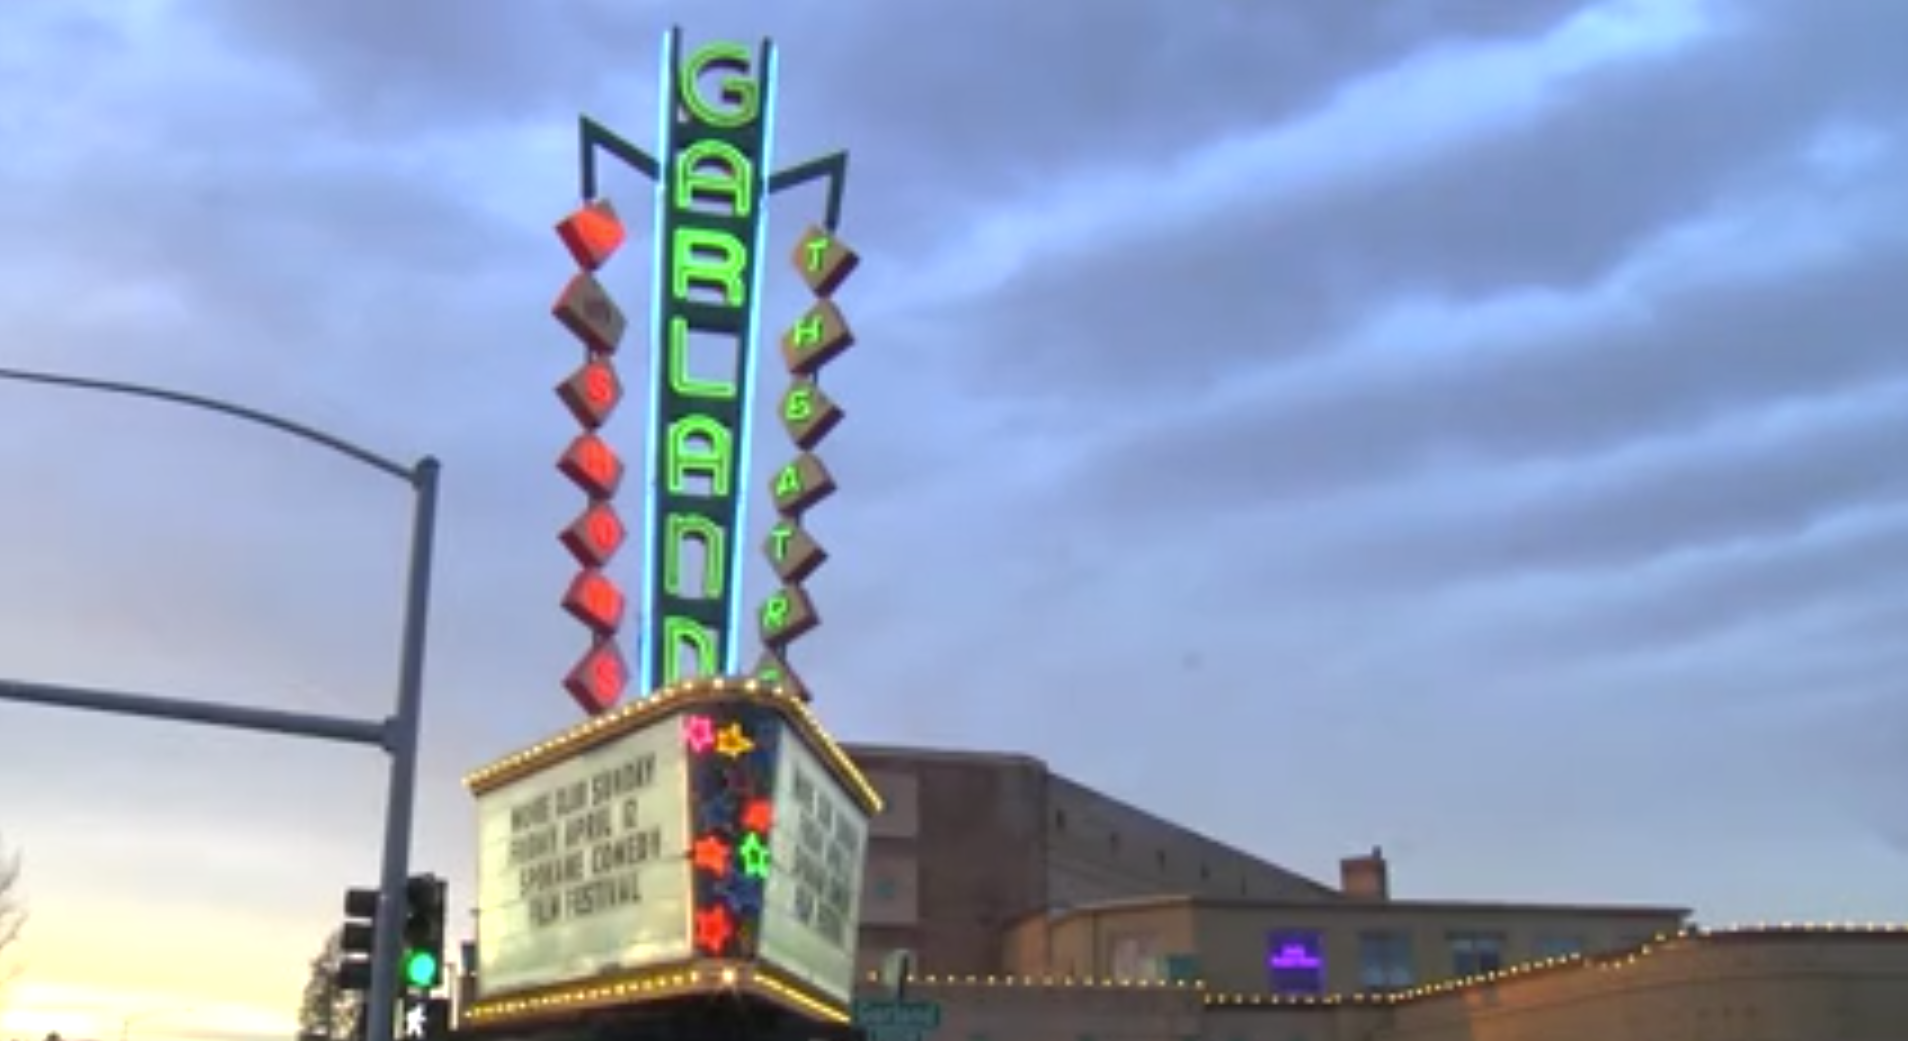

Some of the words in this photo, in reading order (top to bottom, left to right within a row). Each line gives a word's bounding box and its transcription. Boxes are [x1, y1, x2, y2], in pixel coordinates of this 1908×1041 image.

[592, 752, 657, 806] SUNDAY
[511, 824, 557, 864] FRIDAY
[565, 806, 612, 846] APRIL
[520, 850, 584, 898] SPOKANE
[592, 824, 661, 874] COMEDY
[529, 892, 560, 927] FILM
[566, 871, 642, 920] FESTIVAL
